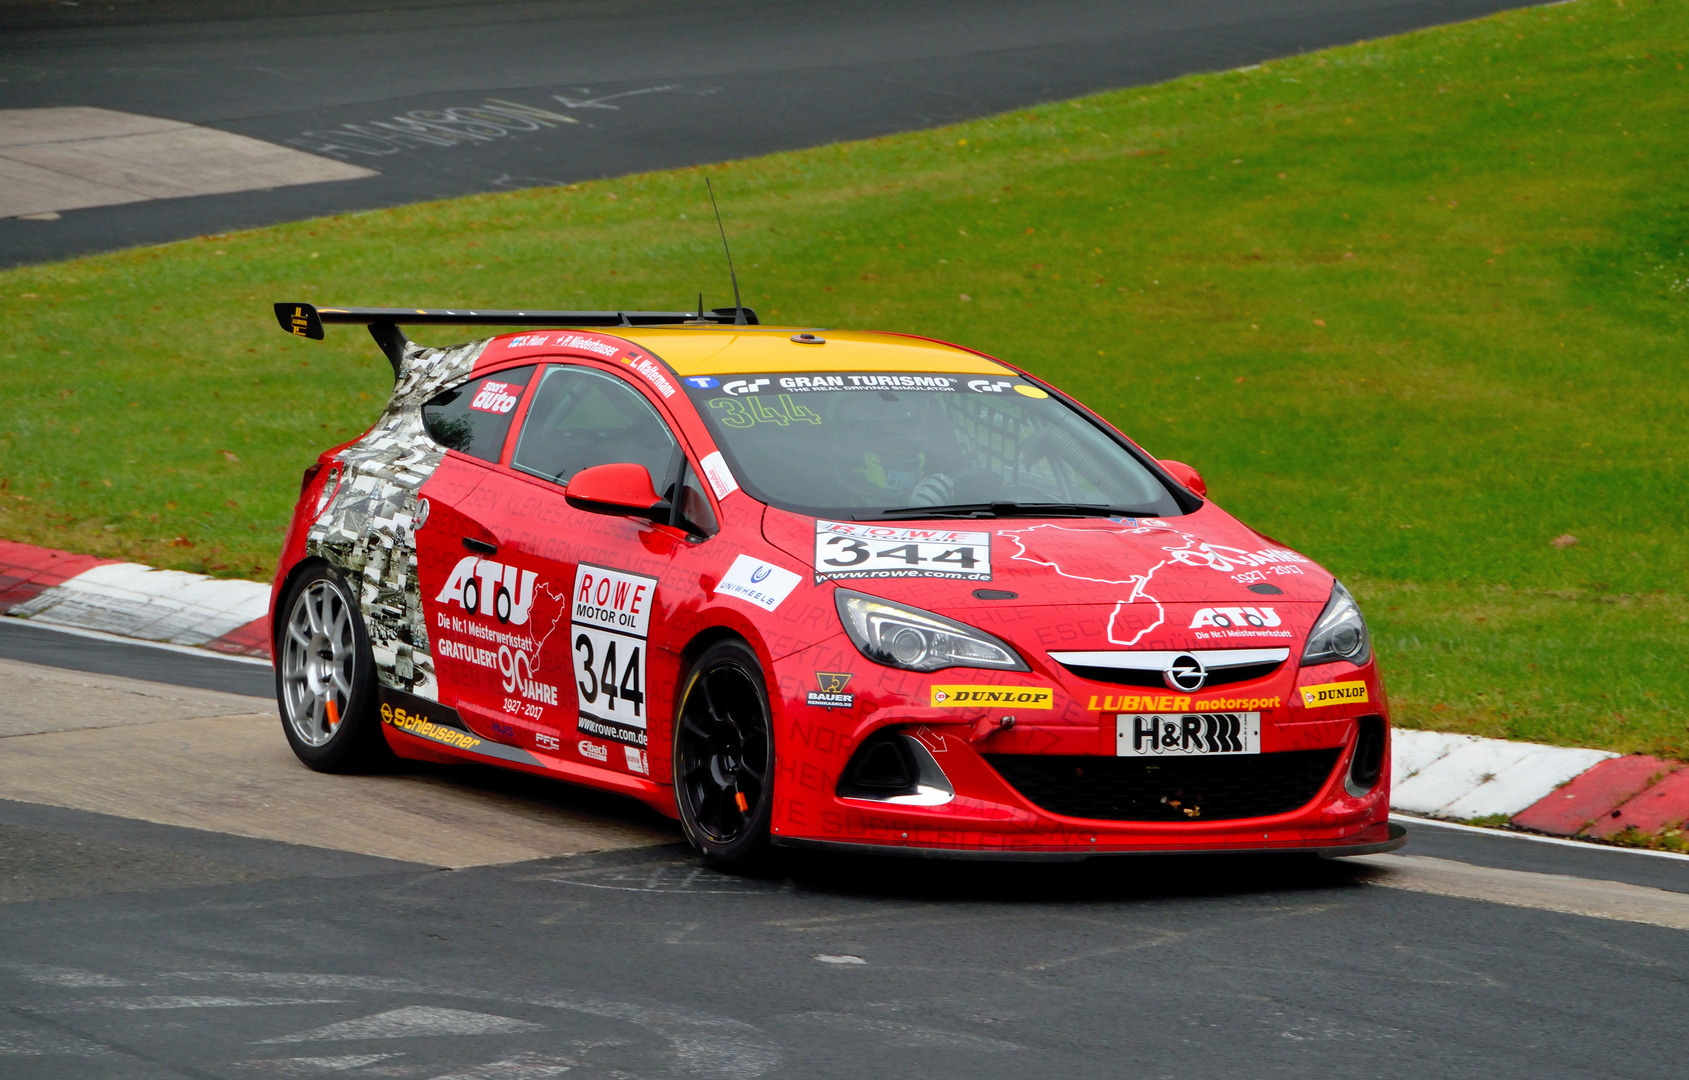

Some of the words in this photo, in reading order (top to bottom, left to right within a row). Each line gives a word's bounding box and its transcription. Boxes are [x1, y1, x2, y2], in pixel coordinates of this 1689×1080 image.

[528, 335, 549, 347] Hunt
[569, 336, 619, 357] Niederhauser
[483, 381, 508, 393] sport
[636, 357, 676, 399] Waltermann
[780, 376, 844, 388] GRAN
[472, 391, 517, 413] auto
[709, 394, 822, 429] 344
[830, 523, 971, 541] ROWE
[823, 536, 982, 569] 344
[1244, 548, 1309, 568] JAHRE
[815, 569, 991, 584] www.rowe.com.de
[1231, 570, 1266, 584] 1927
[1271, 564, 1304, 576] 2017
[578, 573, 647, 614] ROWE
[720, 581, 775, 606] UNIWHEELS
[576, 604, 616, 624] MOTOR
[619, 613, 637, 629] OIL
[438, 611, 451, 630] Die
[452, 616, 467, 634] Nr.1
[468, 622, 534, 652] Meisterwerkstatt
[1195, 631, 1210, 640] Die
[1211, 630, 1227, 639] Nr.1
[1227, 629, 1293, 639] Meisterwerkstatt
[438, 638, 498, 669] GRATULIERT
[497, 644, 533, 693] 90
[574, 632, 645, 717] 344
[521, 679, 558, 706] JAHRE
[808, 692, 853, 702] BAUER
[953, 691, 1049, 703] DUNLOP
[1088, 695, 1191, 711] LUBNER
[1195, 695, 1281, 711] motorsport
[1317, 686, 1366, 701] DUNLOP
[503, 697, 522, 715] 1927
[525, 703, 544, 721] 2017
[393, 707, 481, 749] Schleusener
[492, 721, 514, 737] HJS
[578, 717, 648, 746] www.rowe.com.de
[536, 732, 560, 748] PFC
[578, 740, 608, 758] Eibach
